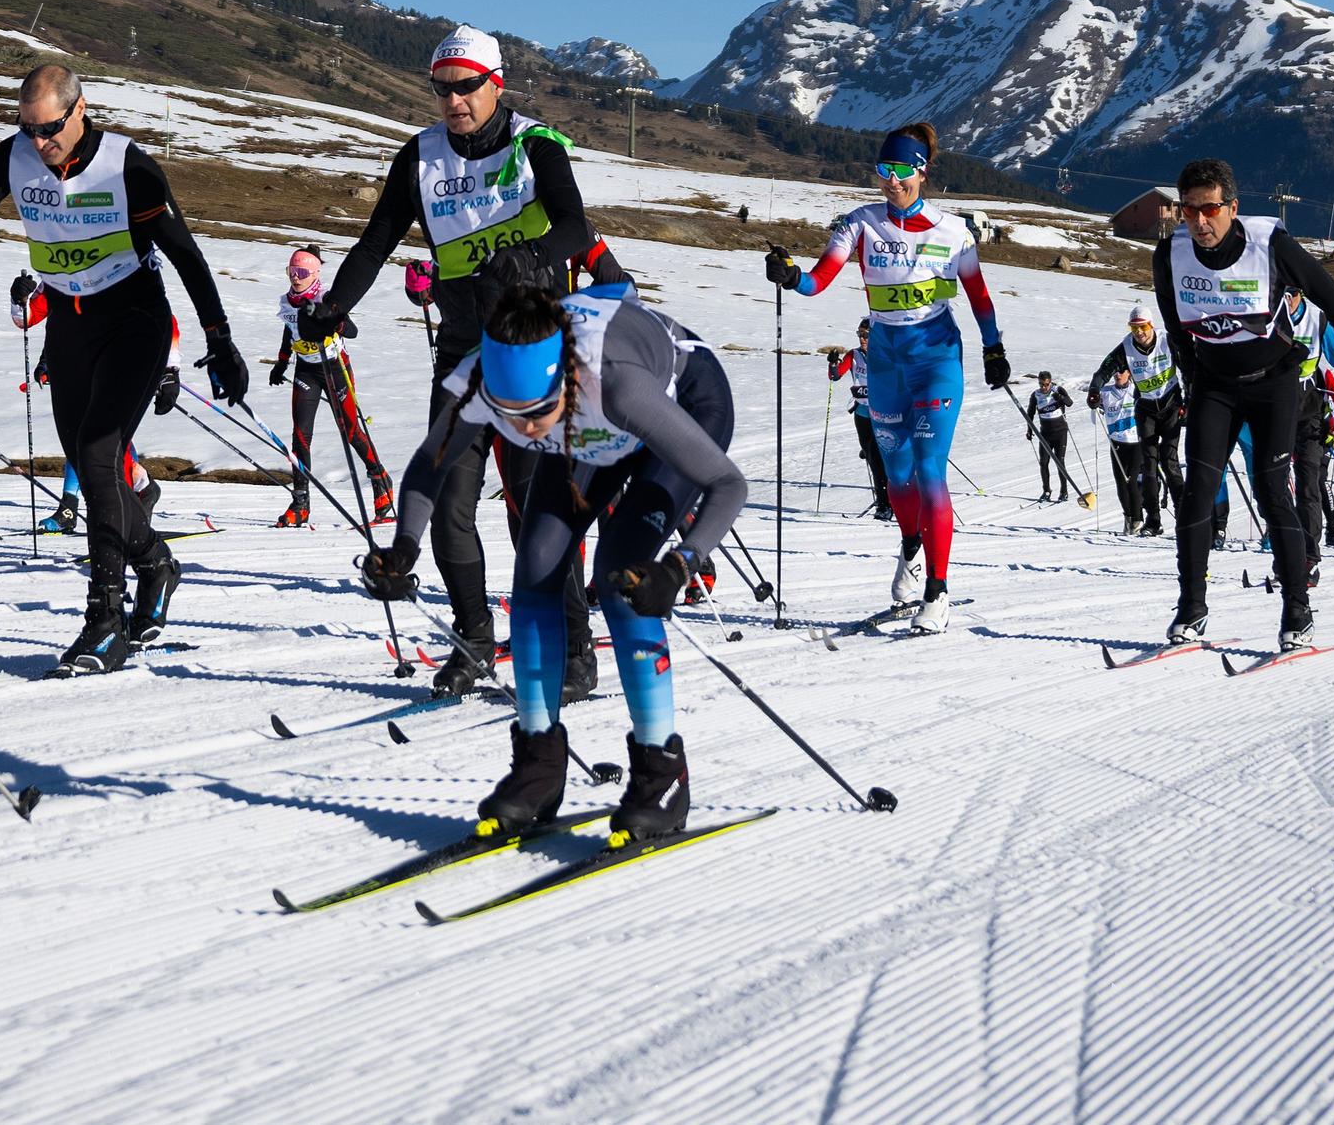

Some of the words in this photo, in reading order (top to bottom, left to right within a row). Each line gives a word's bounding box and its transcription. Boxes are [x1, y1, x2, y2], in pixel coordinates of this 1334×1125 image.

[43, 212, 80, 225] MARXA
[82, 211, 121, 225] BERET
[1198, 295, 1231, 306] MARXA
